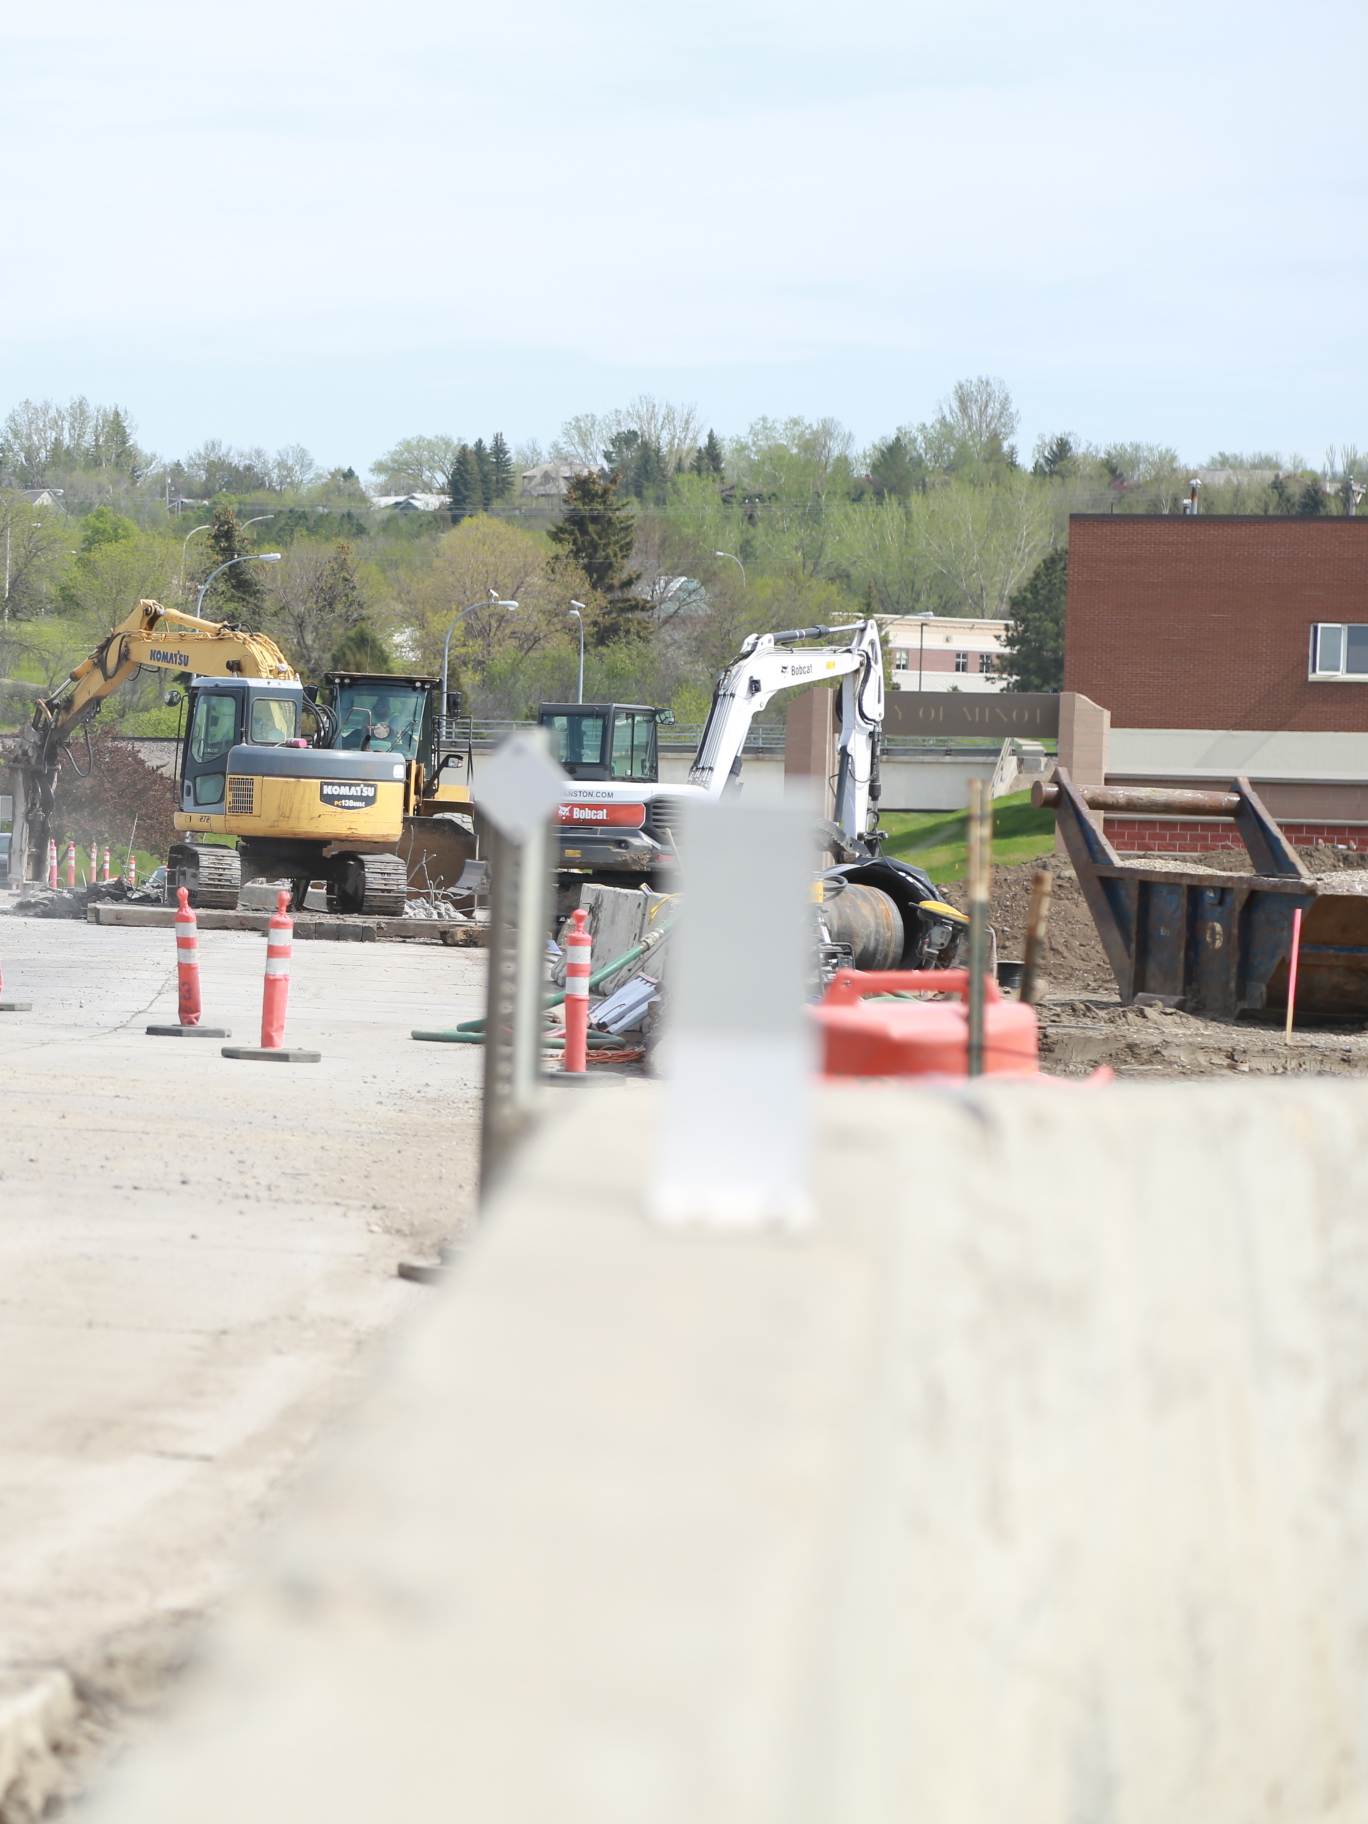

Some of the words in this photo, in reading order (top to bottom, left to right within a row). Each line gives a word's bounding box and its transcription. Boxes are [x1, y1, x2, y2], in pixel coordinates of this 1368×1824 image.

[150, 649, 189, 667] KOMATSU
[791, 664, 813, 676] Bobcat
[918, 705, 947, 722] OF
[962, 706, 1045, 724] MINOT
[323, 783, 375, 797] KOMATSU
